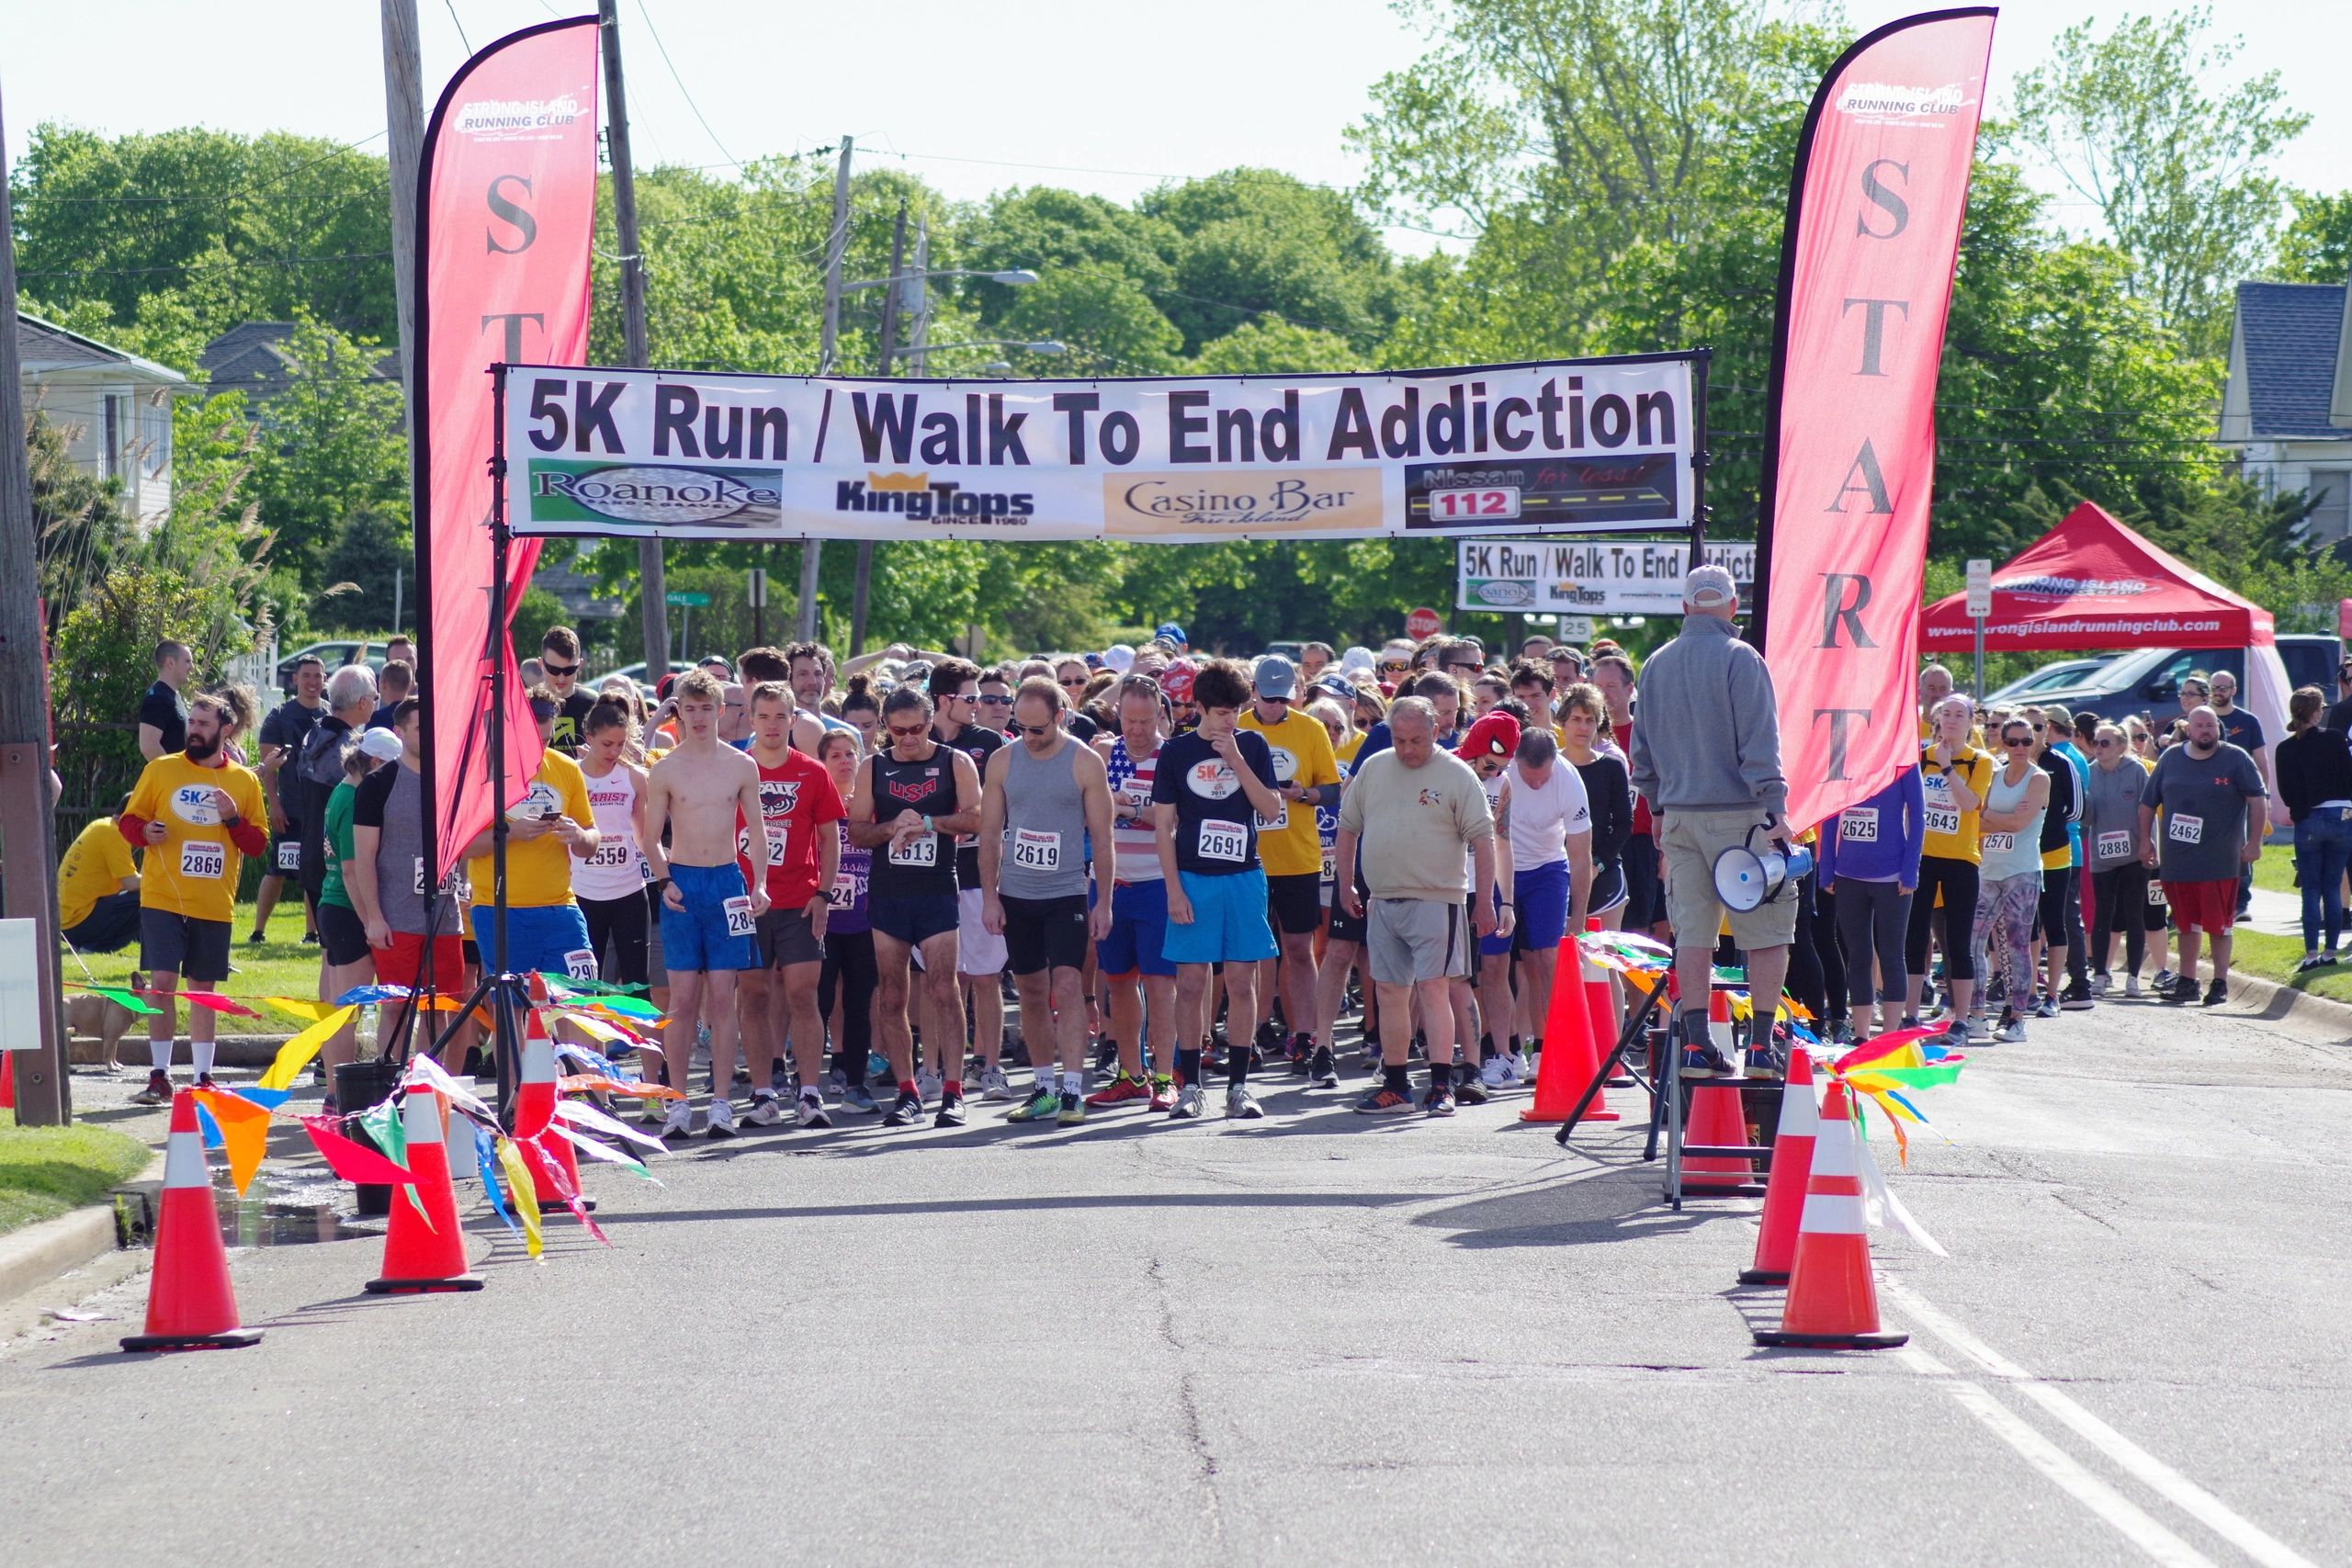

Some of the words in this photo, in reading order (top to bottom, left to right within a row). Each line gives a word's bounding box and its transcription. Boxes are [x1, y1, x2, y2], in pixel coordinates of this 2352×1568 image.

[1847, 98, 1916, 112] RUNNING
[1920, 103, 1959, 115] CLUB
[464, 116, 531, 129] RUNNING
[537, 115, 574, 126] CLUB
[526, 378, 628, 456] 5K
[653, 383, 788, 461] Run
[812, 389, 833, 463] /
[851, 392, 1031, 466] Walk
[1052, 392, 1141, 466] To
[1168, 389, 1301, 466] End
[1326, 375, 1678, 461] Addiction
[532, 470, 781, 505] Roanoke
[1423, 468, 1525, 490] Nissan
[660, 502, 733, 510] GRAVEL
[836, 480, 1035, 525] KingTops
[1124, 480, 1257, 518] Casino
[1270, 479, 1355, 514] Bar
[1440, 491, 1508, 516] 112
[931, 514, 980, 525] SINCE
[1465, 546, 1492, 577] 5K
[1499, 546, 1537, 578] Run
[1555, 547, 1604, 579] Walk
[1611, 547, 1635, 579] To
[1643, 547, 1679, 579] End
[1408, 616, 1440, 631] STOP
[1565, 622, 1588, 636] 25
[1197, 764, 1217, 779] 5K
[889, 777, 937, 803] USA
[1925, 776, 1944, 789] 5K
[179, 789, 201, 804] 5K
[588, 790, 629, 802] ARIST
[765, 818, 792, 828] ROSSE
[1842, 819, 1876, 838] 2625
[2171, 823, 2200, 840] 2462
[1200, 834, 1243, 857] 2691
[1984, 834, 2013, 850] 2570
[2099, 840, 2130, 855] 2888
[279, 852, 300, 866] 288
[1015, 843, 1057, 866] 2619
[182, 854, 222, 874] 2869
[831, 886, 854, 907] 24
[2149, 889, 2165, 902] 27
[571, 964, 598, 981] 290
